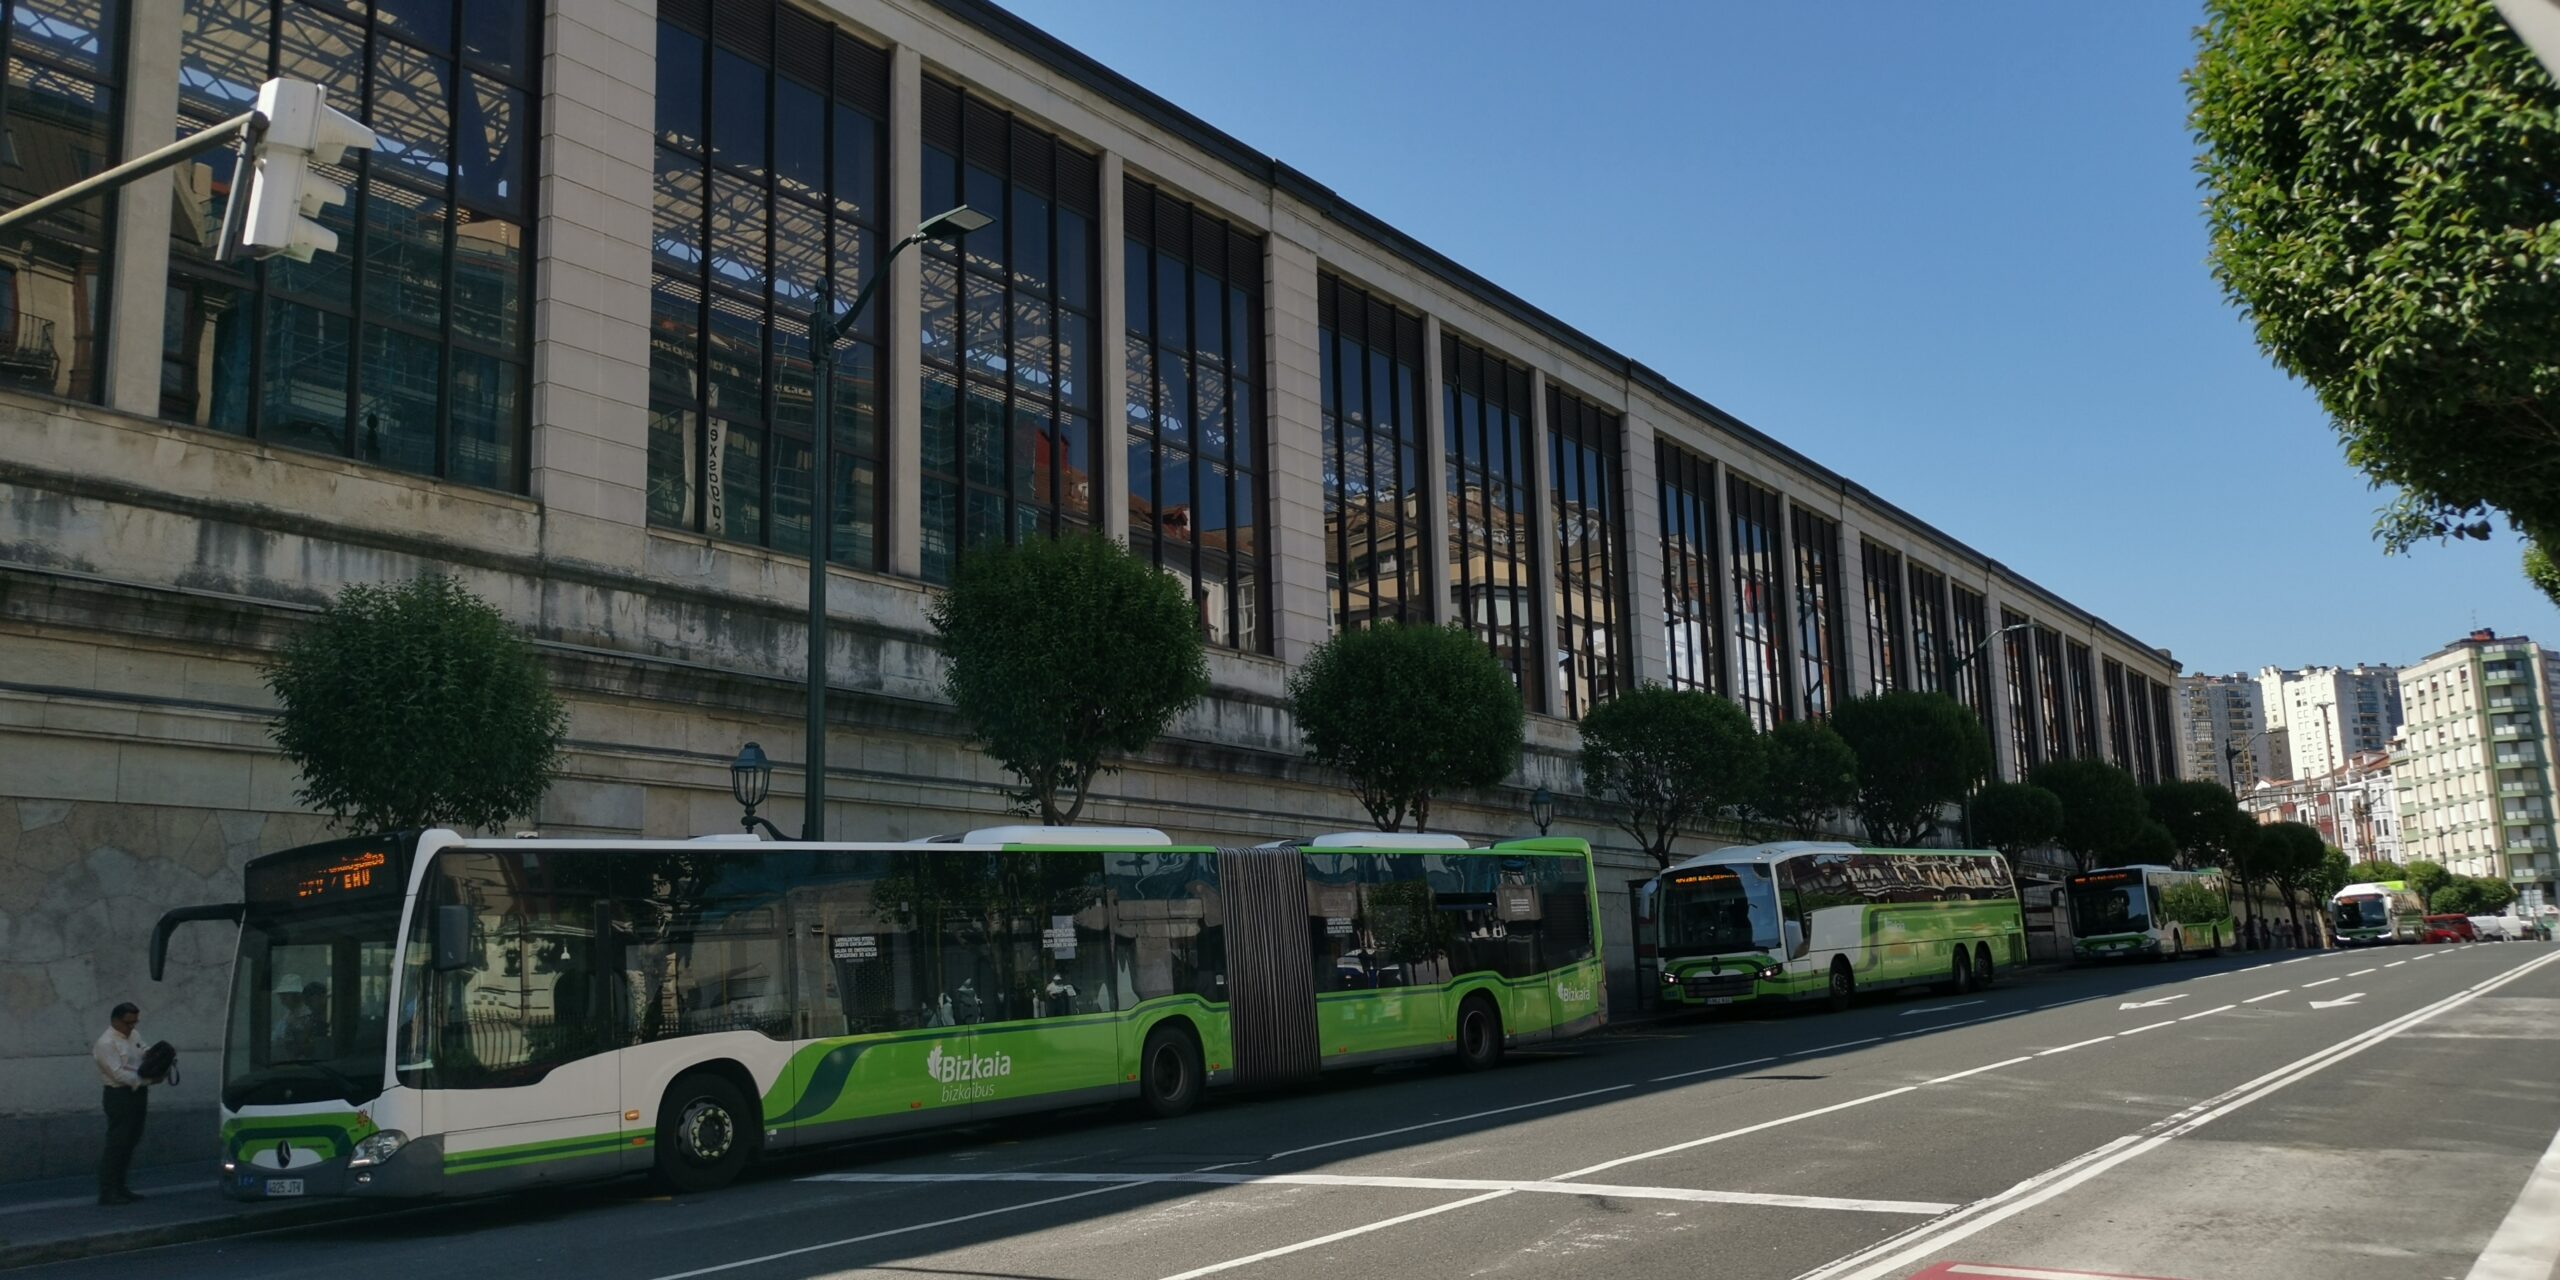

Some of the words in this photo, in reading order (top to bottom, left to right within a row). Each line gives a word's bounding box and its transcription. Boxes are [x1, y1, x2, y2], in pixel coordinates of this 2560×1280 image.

[343, 868, 371, 889] EHU
[1564, 987, 1590, 1001] Bizkaia
[941, 1051, 1011, 1083] Bizkaia
[941, 1082, 995, 1103] bizkaibus
